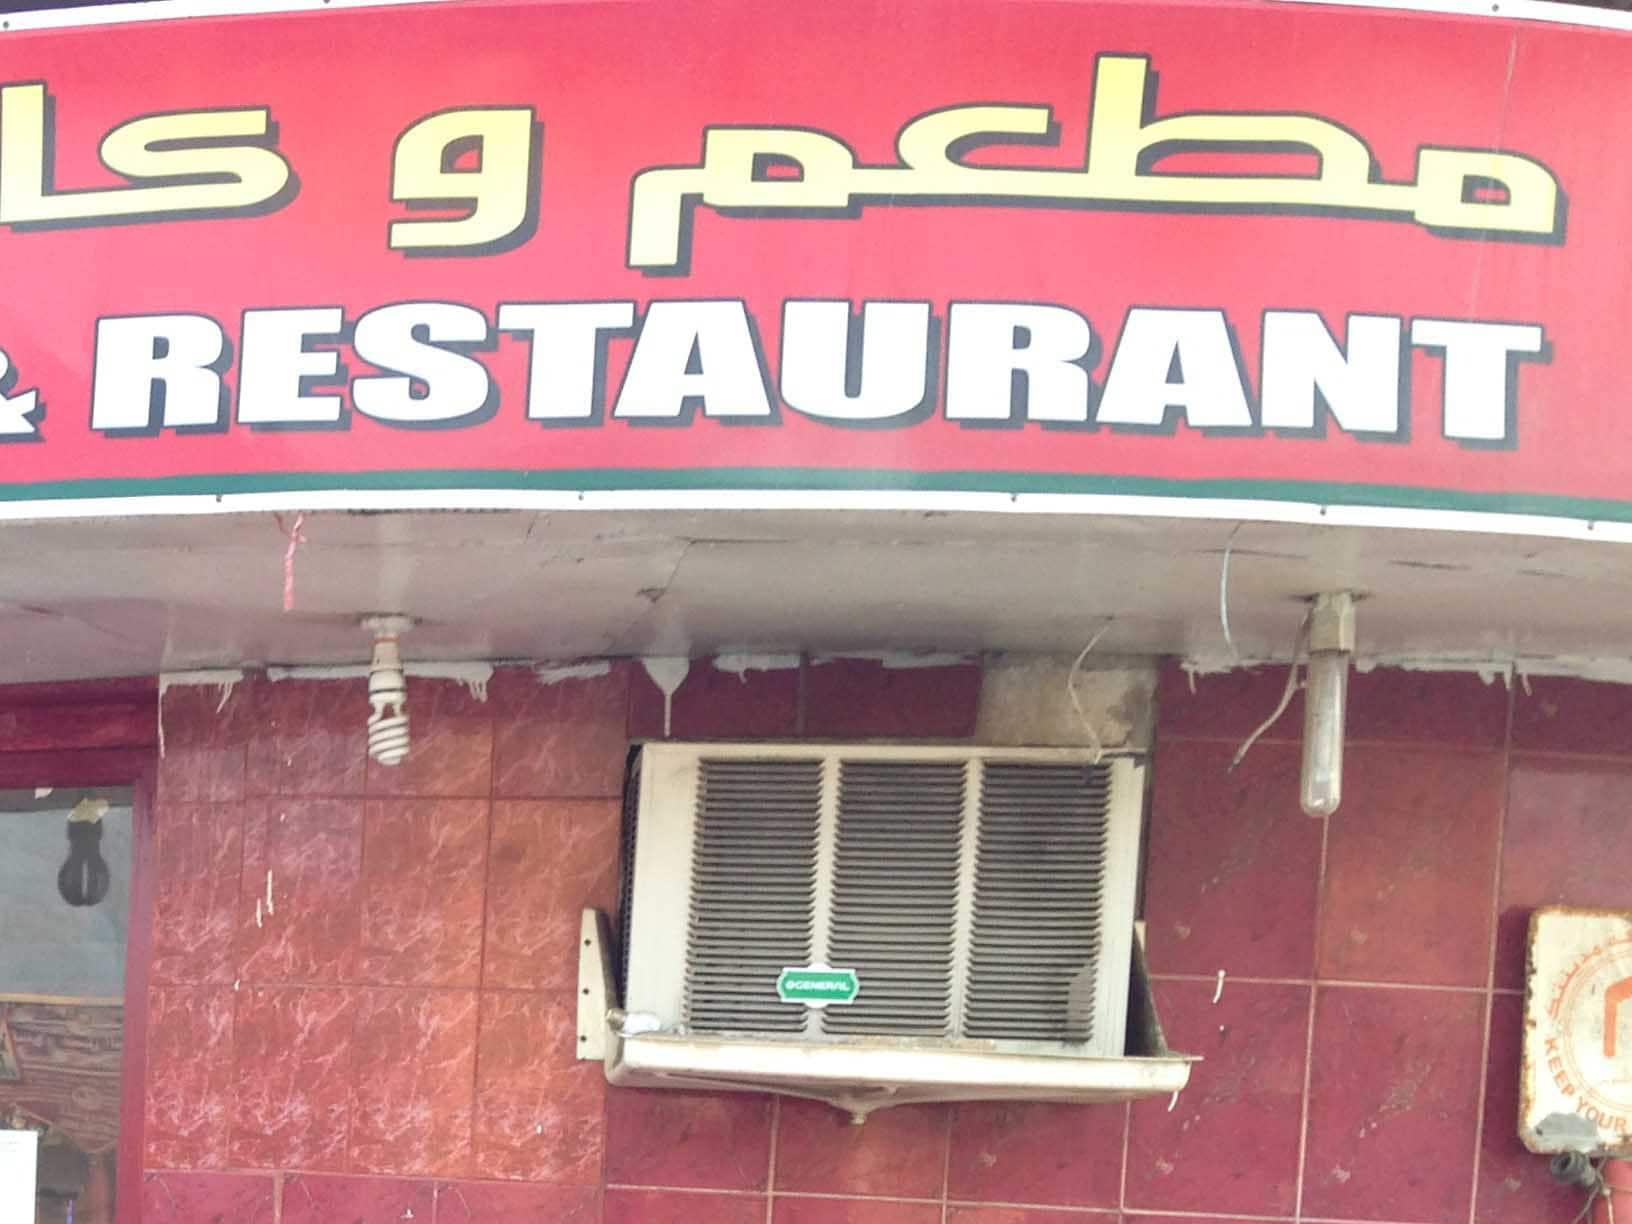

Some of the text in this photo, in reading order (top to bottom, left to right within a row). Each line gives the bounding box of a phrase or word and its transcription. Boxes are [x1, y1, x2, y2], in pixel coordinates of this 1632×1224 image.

[388, 105, 536, 252] و
[629, 55, 1557, 268] مطعم
[90, 299, 1543, 442] RESTAURANT
[1544, 1036, 1627, 1131] KEEP YOUR
